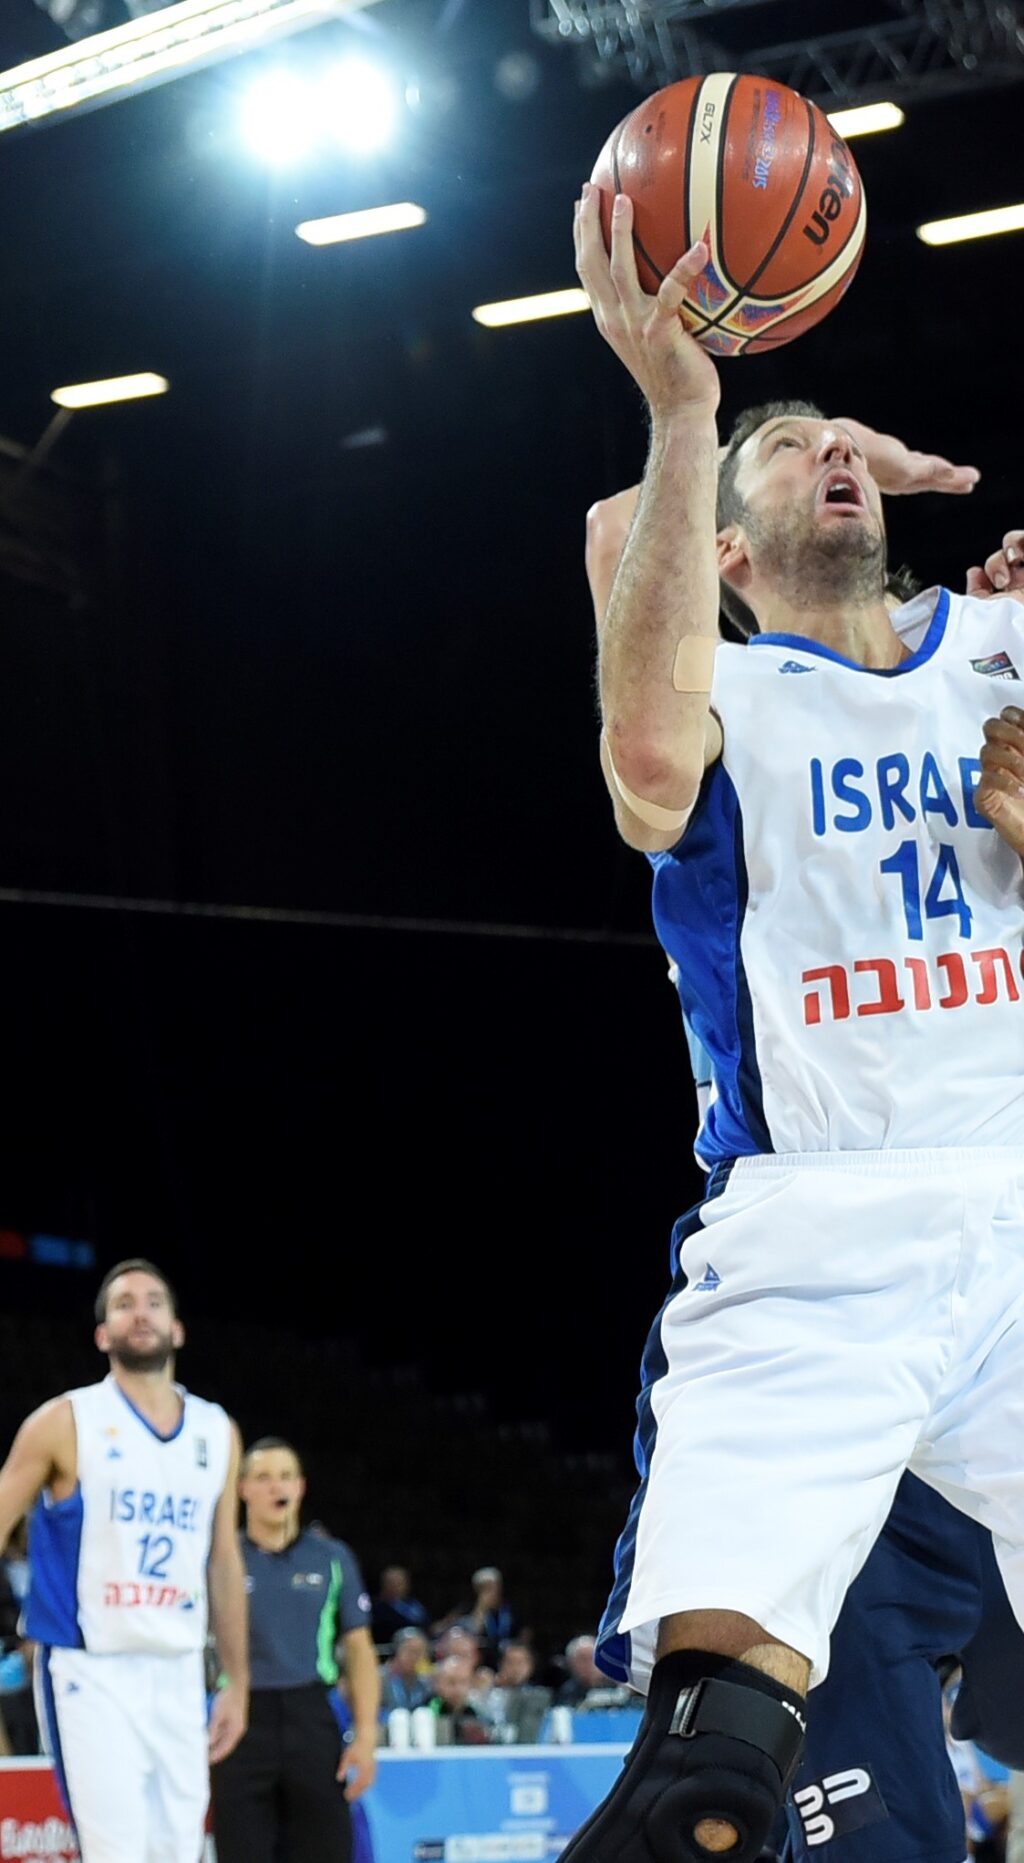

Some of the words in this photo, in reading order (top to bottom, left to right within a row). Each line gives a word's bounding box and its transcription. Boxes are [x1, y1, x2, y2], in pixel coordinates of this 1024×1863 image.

[701, 102, 716, 145] GL7X
[810, 752, 994, 837] ISRAE
[880, 839, 973, 941] 14
[802, 947, 1020, 1026] תנובה
[137, 1533, 174, 1578] 12
